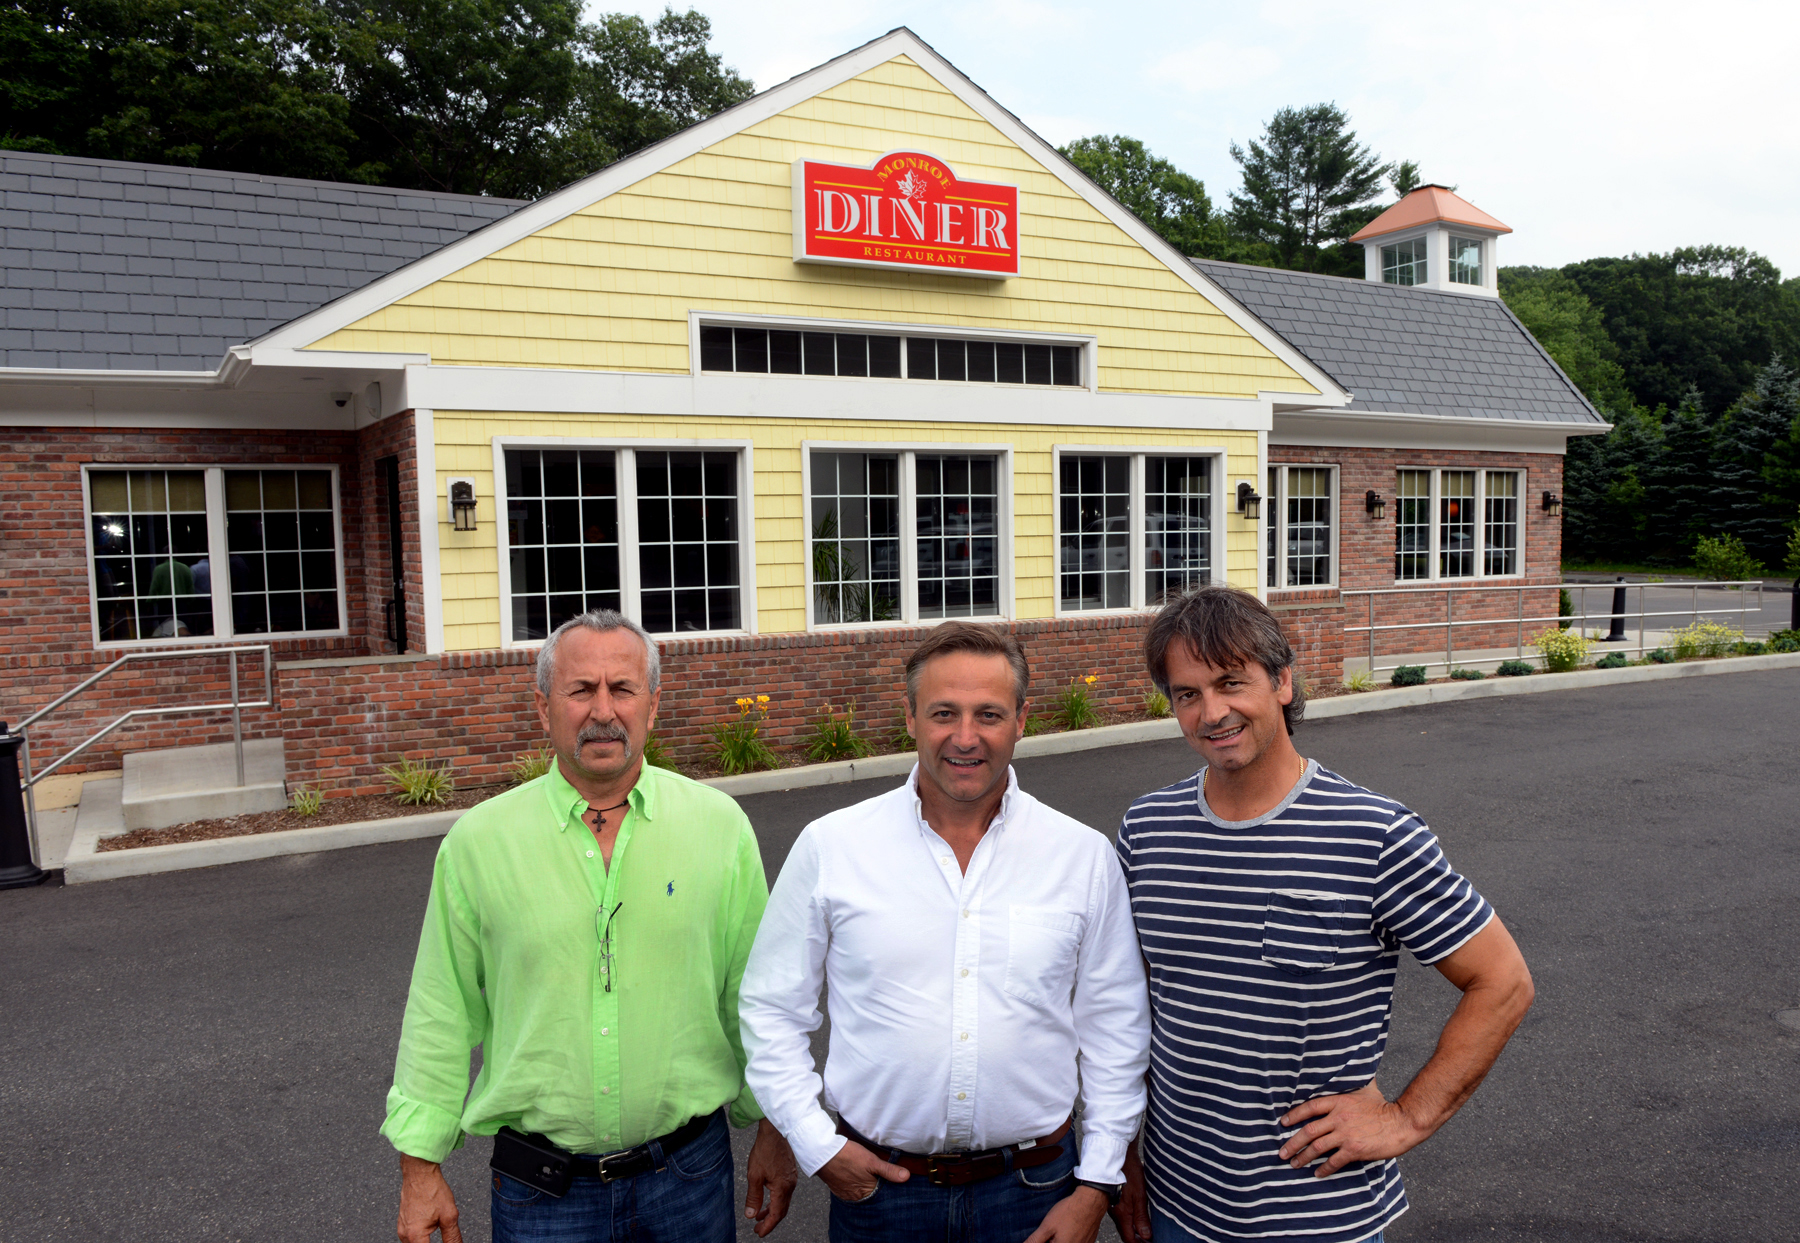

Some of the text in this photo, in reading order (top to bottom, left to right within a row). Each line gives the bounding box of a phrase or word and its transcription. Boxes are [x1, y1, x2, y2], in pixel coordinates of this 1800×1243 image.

[877, 157, 951, 190] MONROE
[814, 189, 1011, 249] DINER
[864, 247, 967, 264] RESTAURANT
